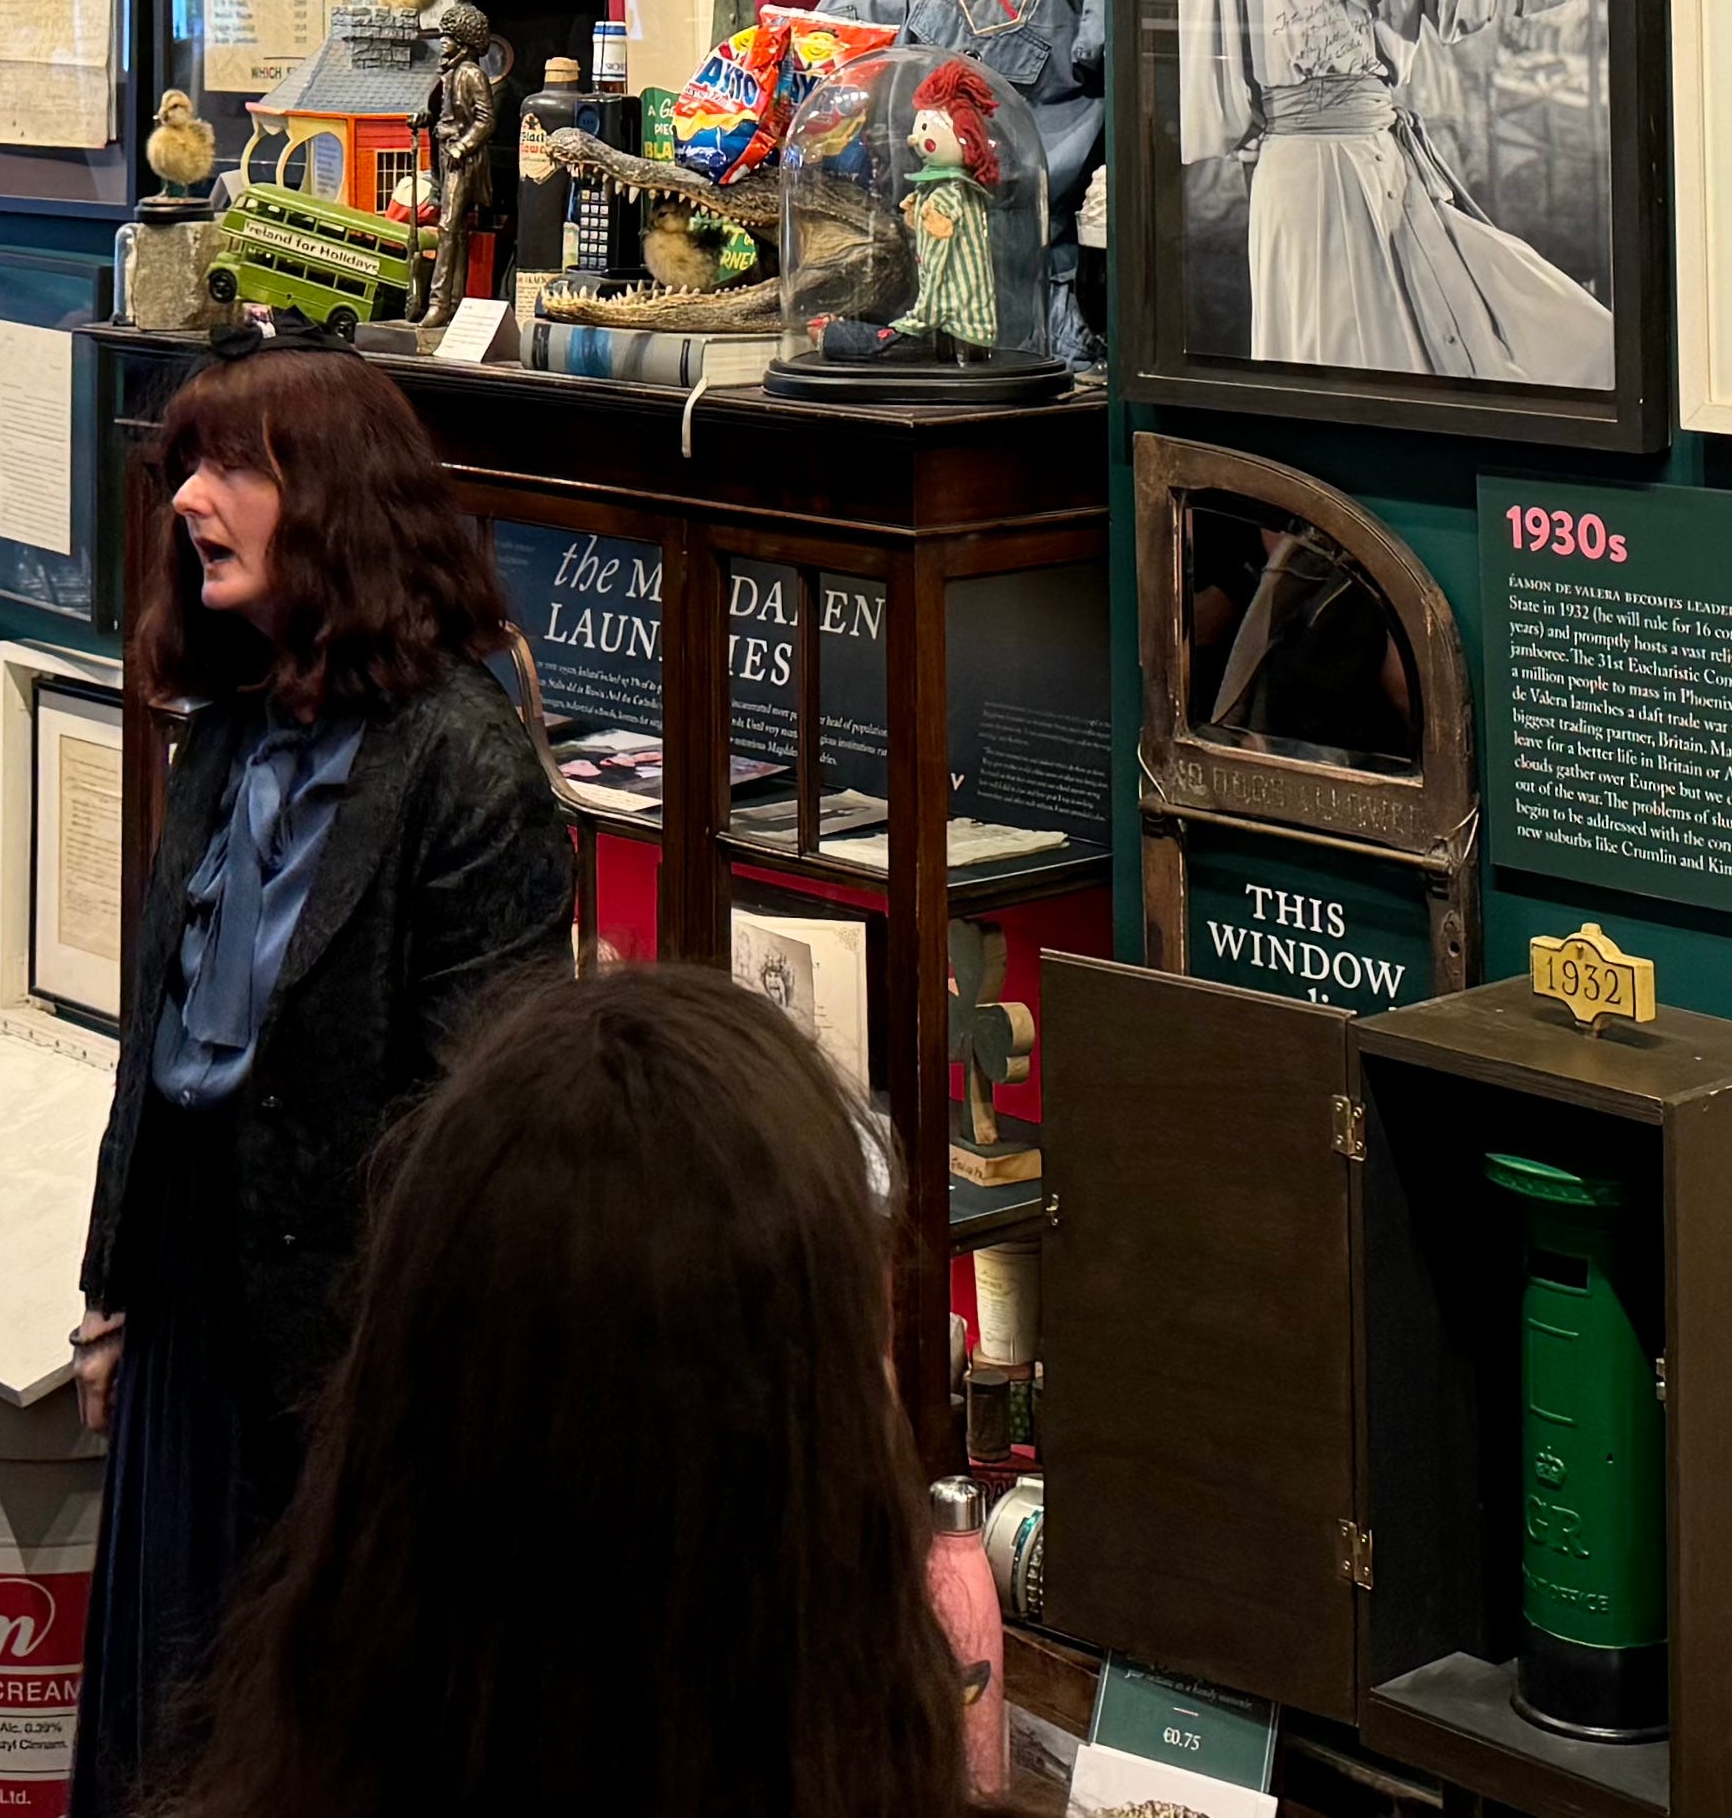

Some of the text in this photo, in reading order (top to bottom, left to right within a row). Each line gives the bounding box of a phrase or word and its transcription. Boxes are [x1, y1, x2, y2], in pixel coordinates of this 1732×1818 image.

[251, 67, 281, 80] WHICH
[296, 238, 316, 253] for
[320, 246, 379, 272] Holidays
[1506, 504, 1628, 563] 1930s
[554, 534, 619, 594] the
[1509, 594, 1539, 612] State
[1542, 599, 1554, 614] in
[1560, 602, 1588, 619] 1932
[1593, 606, 1613, 623] (he
[1616, 611, 1639, 626] will
[1644, 614, 1668, 630] rule
[1672, 617, 1690, 633] for
[1695, 621, 1711, 636] 16
[1245, 883, 1345, 938] THIS
[1206, 920, 1406, 999] WINDOW
[1547, 956, 1622, 1005] 1932
[1163, 1726, 1202, 1750] €0.75
[0, 1788, 32, 1805] Ltd.
